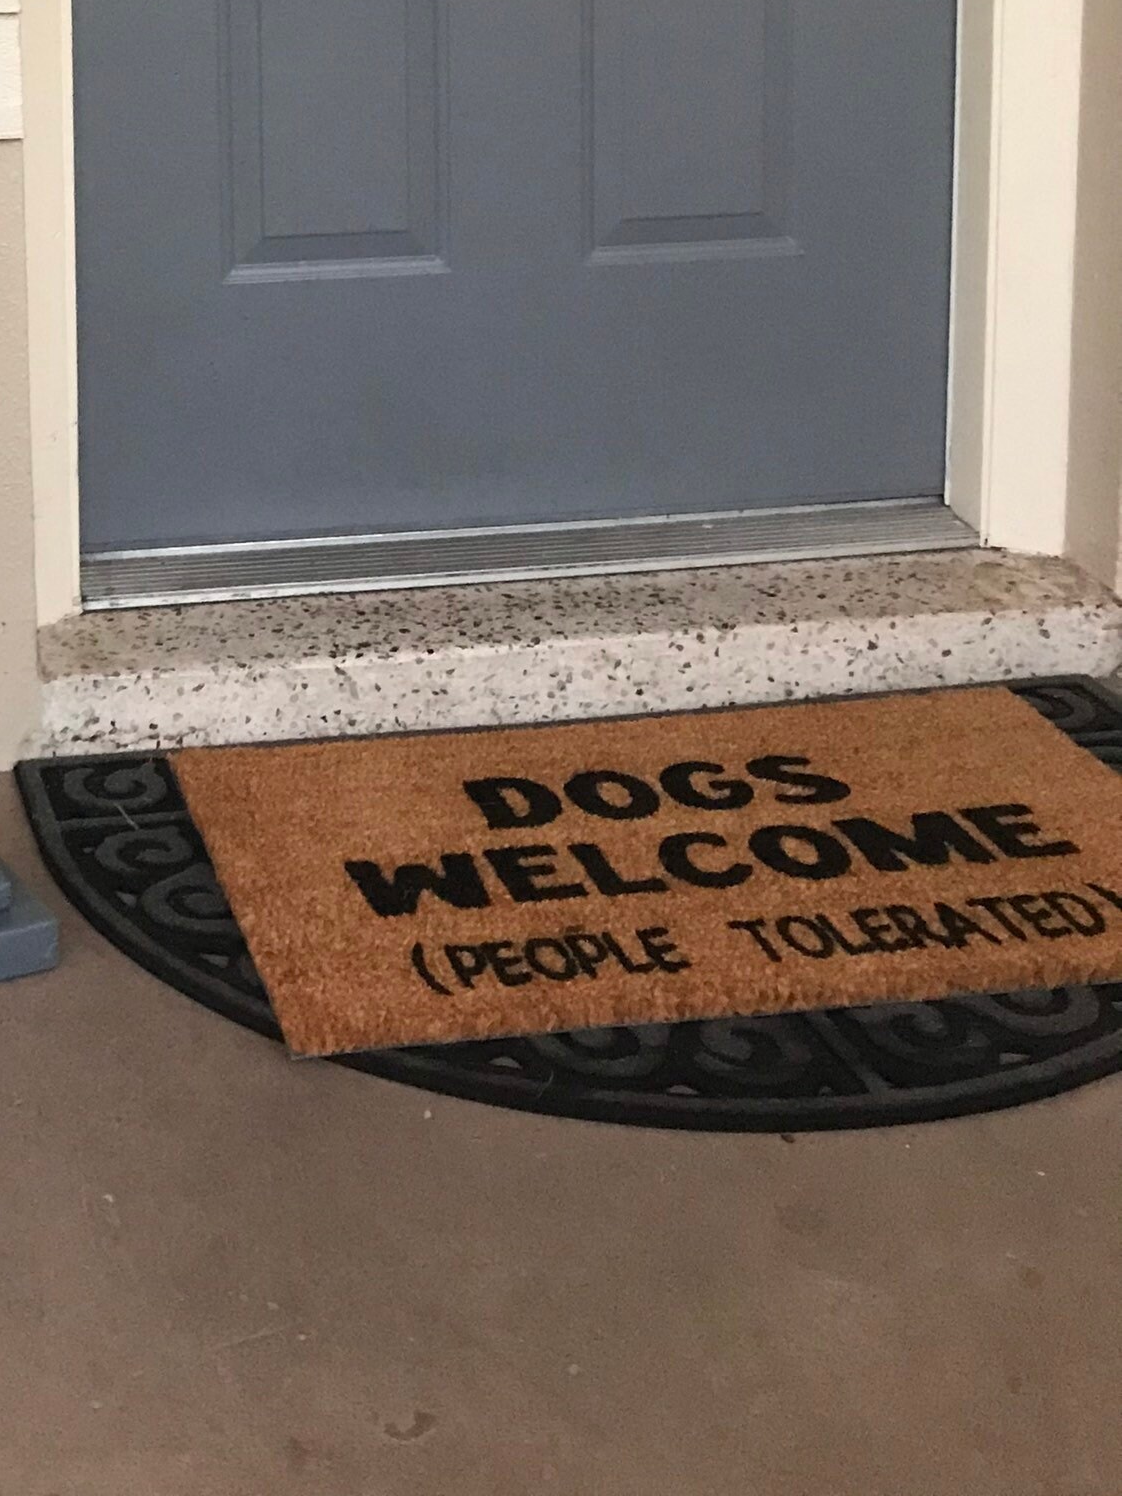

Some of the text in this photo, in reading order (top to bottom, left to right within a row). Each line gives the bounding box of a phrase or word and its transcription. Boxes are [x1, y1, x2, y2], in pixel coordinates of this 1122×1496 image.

[462, 754, 852, 831] DOGS
[343, 803, 1081, 919] WELCOME
[410, 925, 692, 997] (PEOPLE
